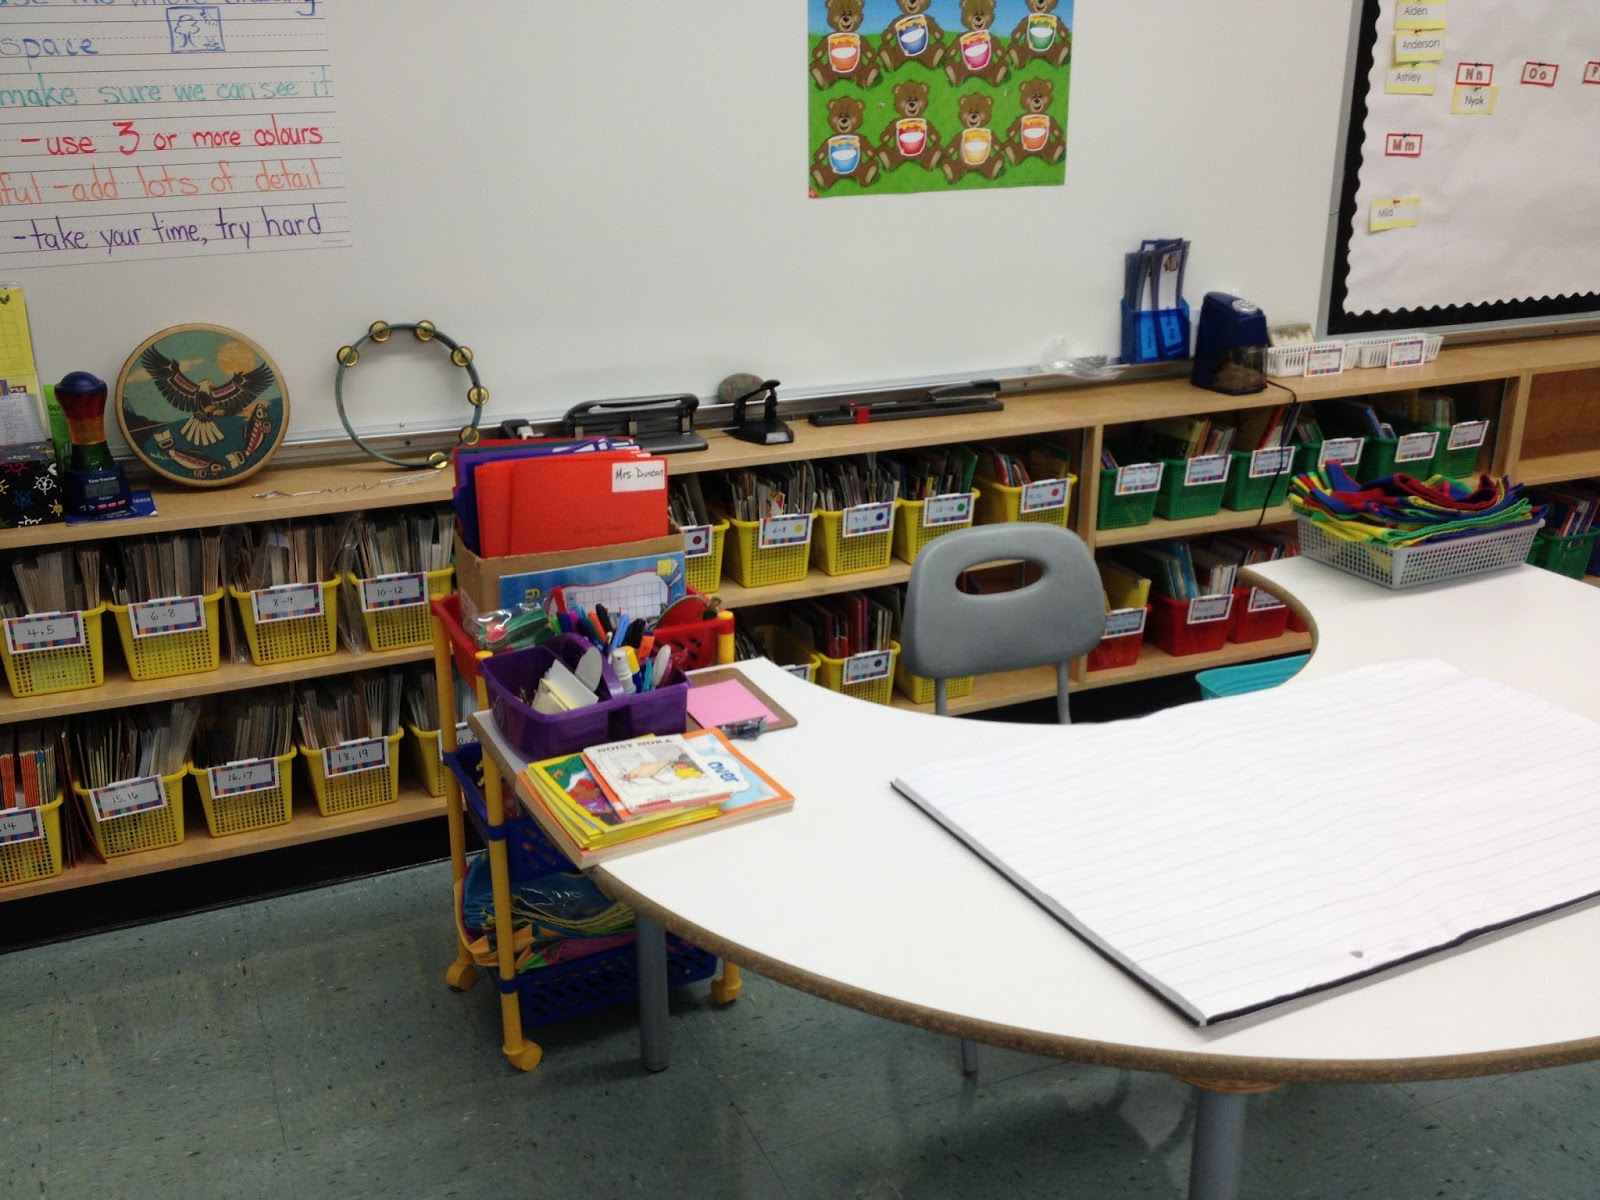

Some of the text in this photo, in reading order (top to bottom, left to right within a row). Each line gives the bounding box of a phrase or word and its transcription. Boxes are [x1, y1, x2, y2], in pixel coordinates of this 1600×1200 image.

[1404, 6, 1428, 16] Aiden
[0, 37, 99, 70] space
[1402, 39, 1440, 50] Anderson
[0, 65, 332, 107] make sure we can see it
[1395, 72, 1422, 83] Ashley
[112, 121, 140, 155] 3
[153, 132, 177, 150] or
[192, 130, 241, 148] more
[253, 114, 323, 146] colours
[0, 172, 42, 205] ful
[136, 165, 199, 198] lots
[210, 160, 235, 193] of
[255, 157, 322, 192] detail
[100, 229, 141, 255] your
[152, 212, 208, 245] time,
[215, 207, 250, 249] try
[261, 203, 322, 237] hard
